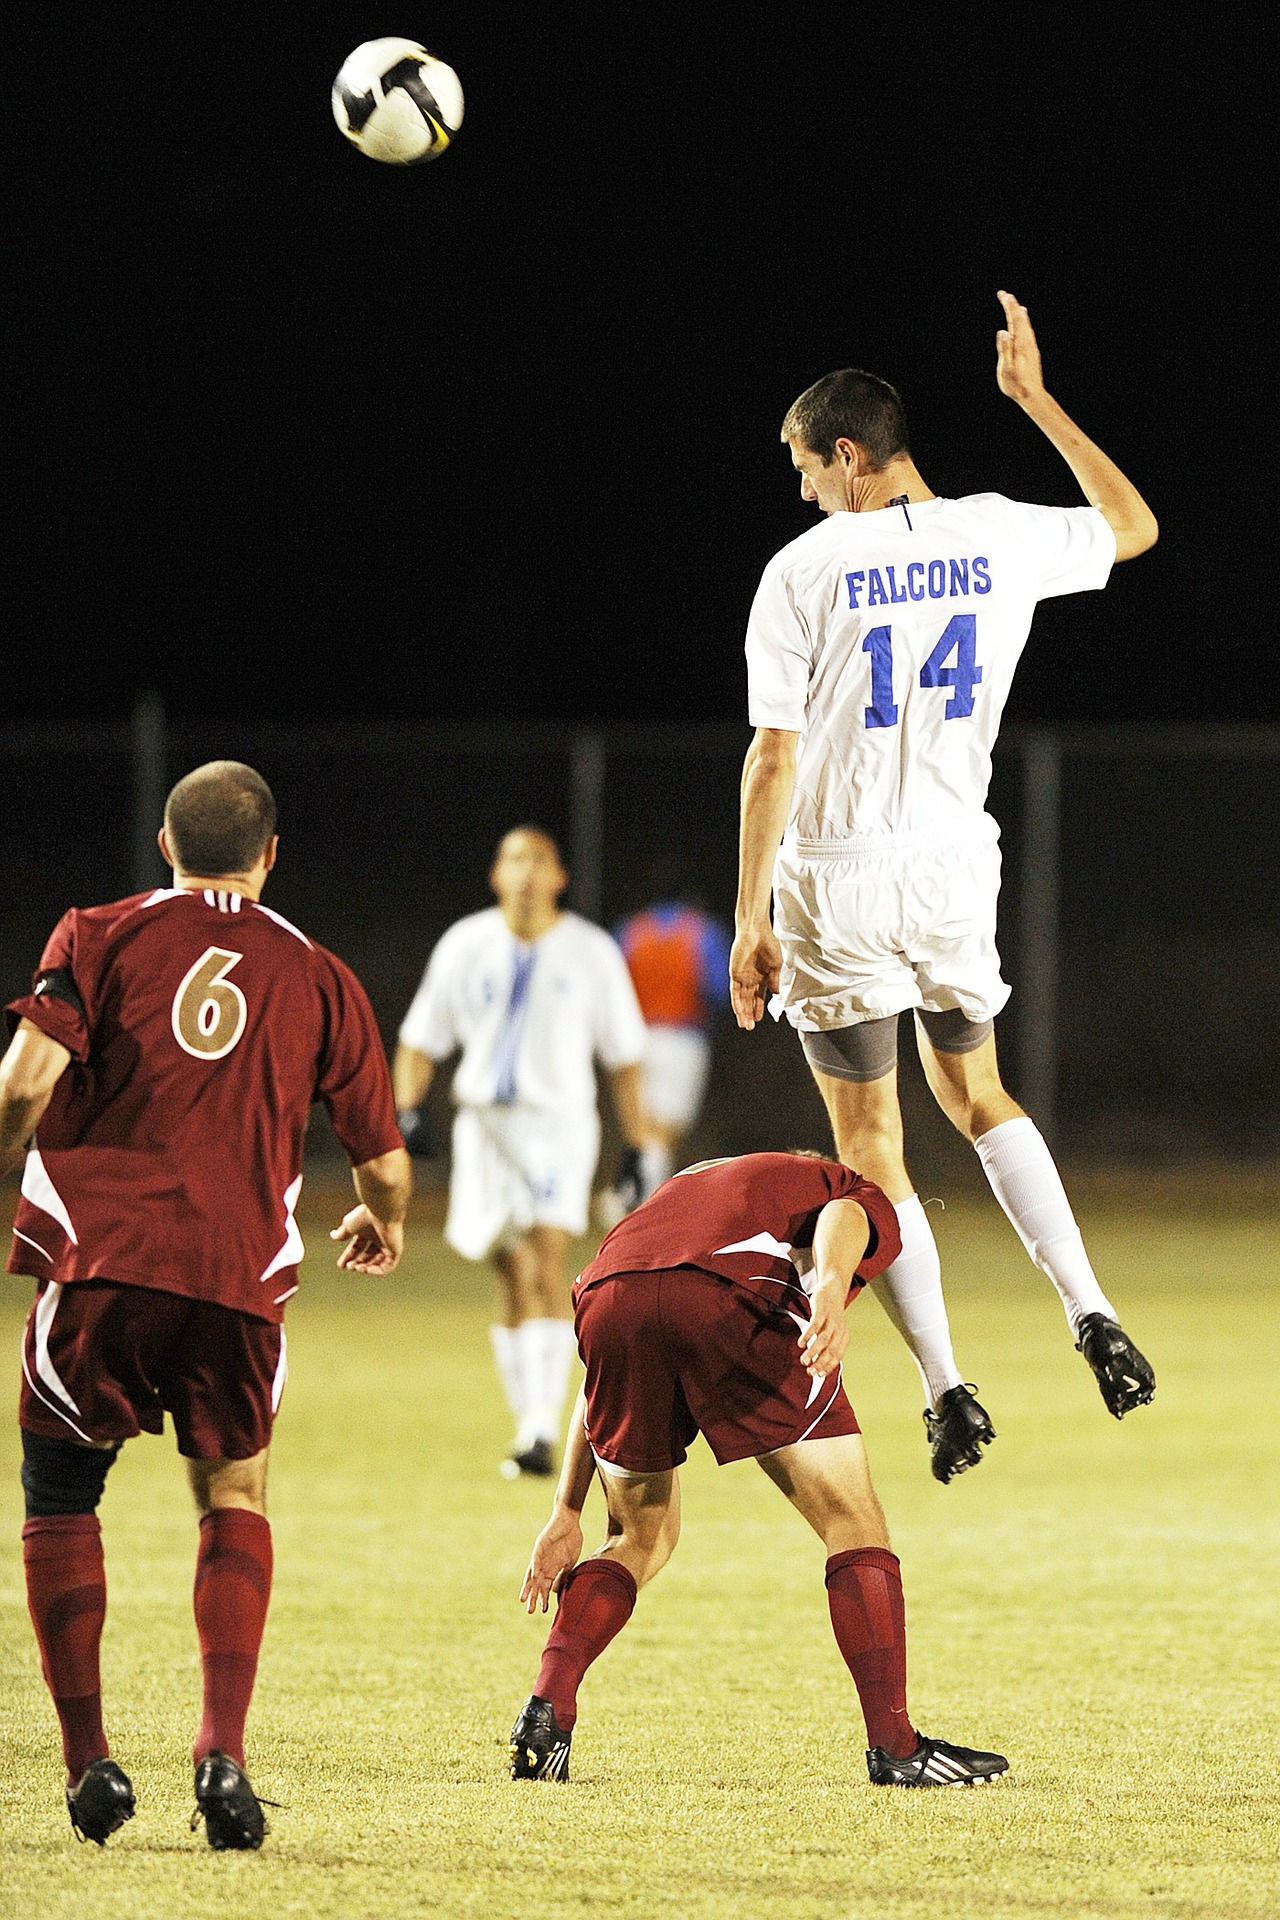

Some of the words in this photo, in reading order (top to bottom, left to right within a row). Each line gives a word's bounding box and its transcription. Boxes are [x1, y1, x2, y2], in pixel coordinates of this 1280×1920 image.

[846, 556, 992, 609] FALCONS
[862, 613, 983, 730] 14
[171, 945, 248, 1061] 6
